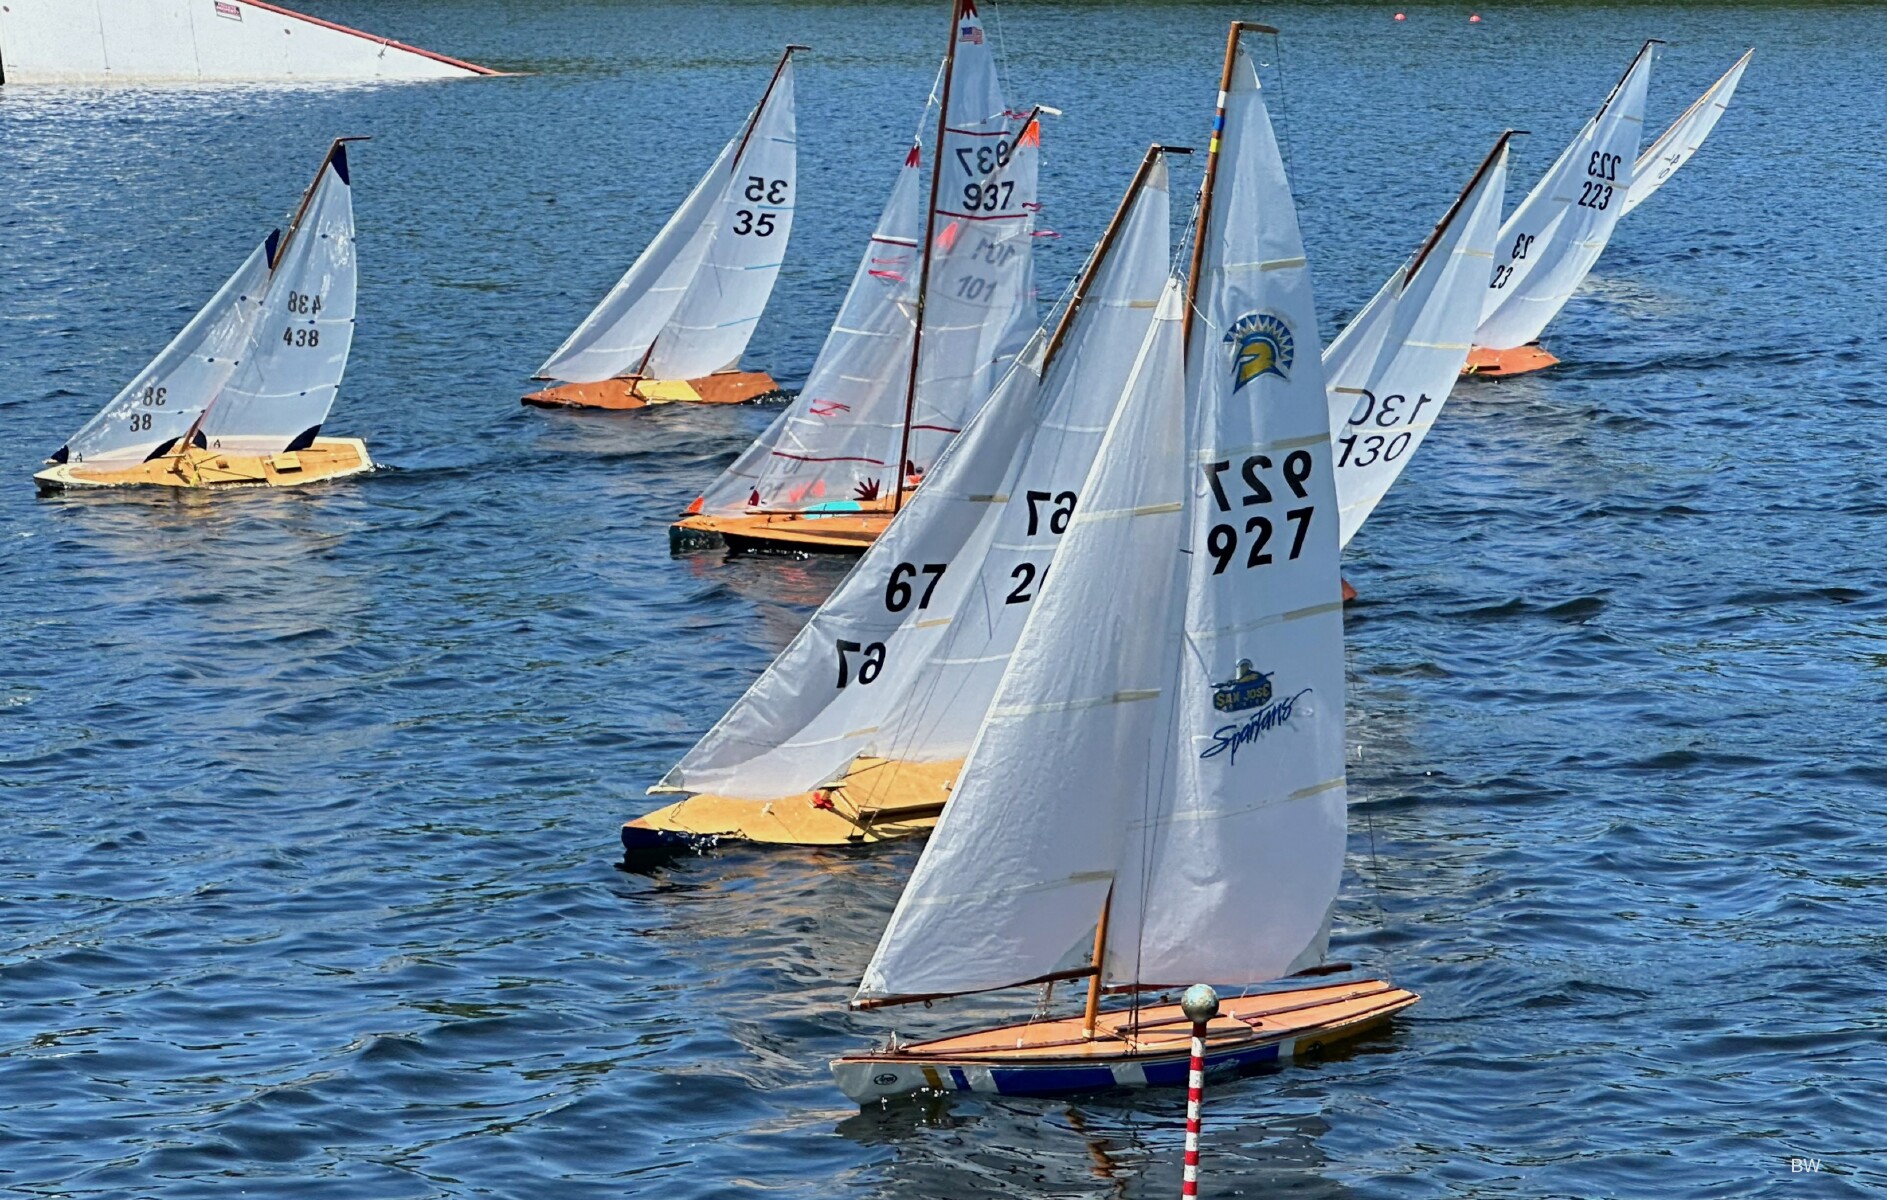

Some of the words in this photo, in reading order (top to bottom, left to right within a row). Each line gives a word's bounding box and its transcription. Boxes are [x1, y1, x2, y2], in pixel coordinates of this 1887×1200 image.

[962, 180, 1015, 212] 937
[1577, 181, 1613, 211] 223
[732, 209, 777, 237] 35
[957, 275, 998, 302] 101
[1489, 264, 1514, 289] 23
[283, 326, 319, 348] 438
[129, 413, 152, 432] 38
[1337, 431, 1412, 468] 130
[1206, 505, 1315, 576] 927
[884, 561, 948, 613] 67
